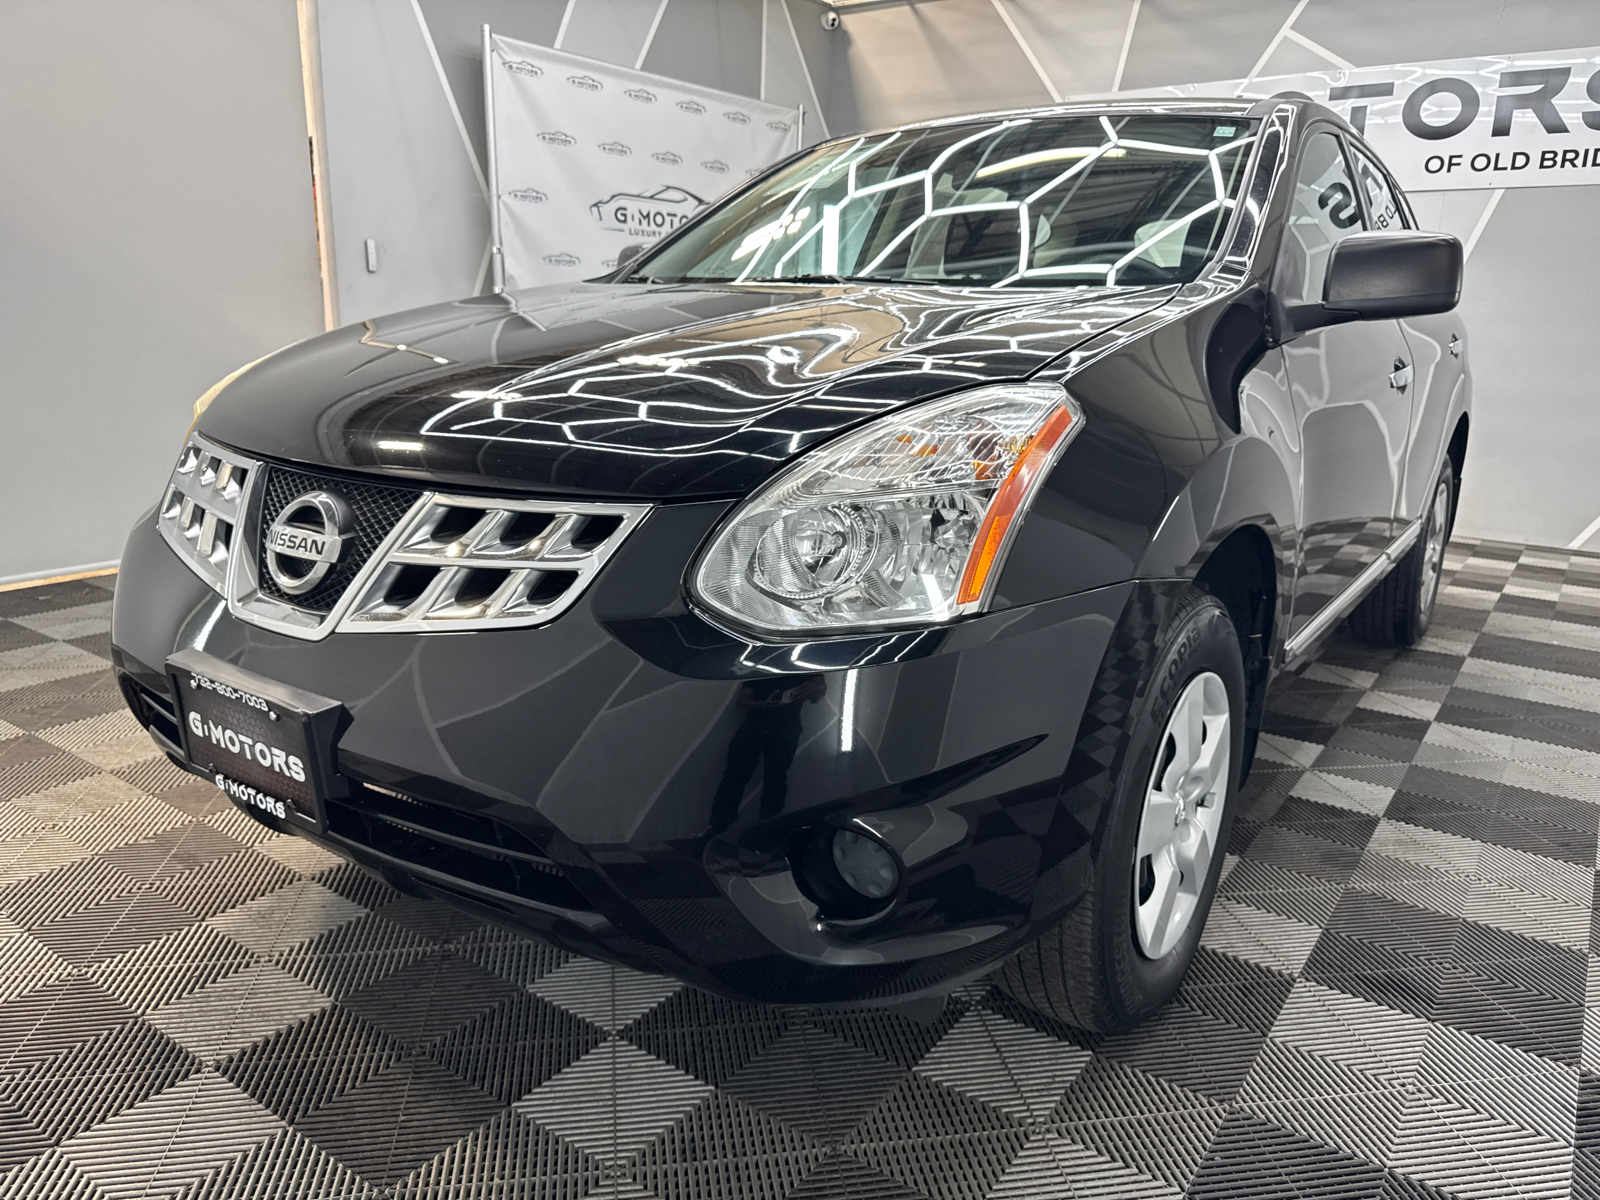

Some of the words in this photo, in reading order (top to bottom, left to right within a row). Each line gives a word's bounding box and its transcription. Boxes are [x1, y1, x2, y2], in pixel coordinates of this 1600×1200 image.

[1424, 154, 1463, 174] OF
[1470, 151, 1531, 173] OLD
[629, 228, 662, 238] LUXURY
[268, 528, 326, 556] NISSAN
[191, 672, 269, 712] 732-800-7003
